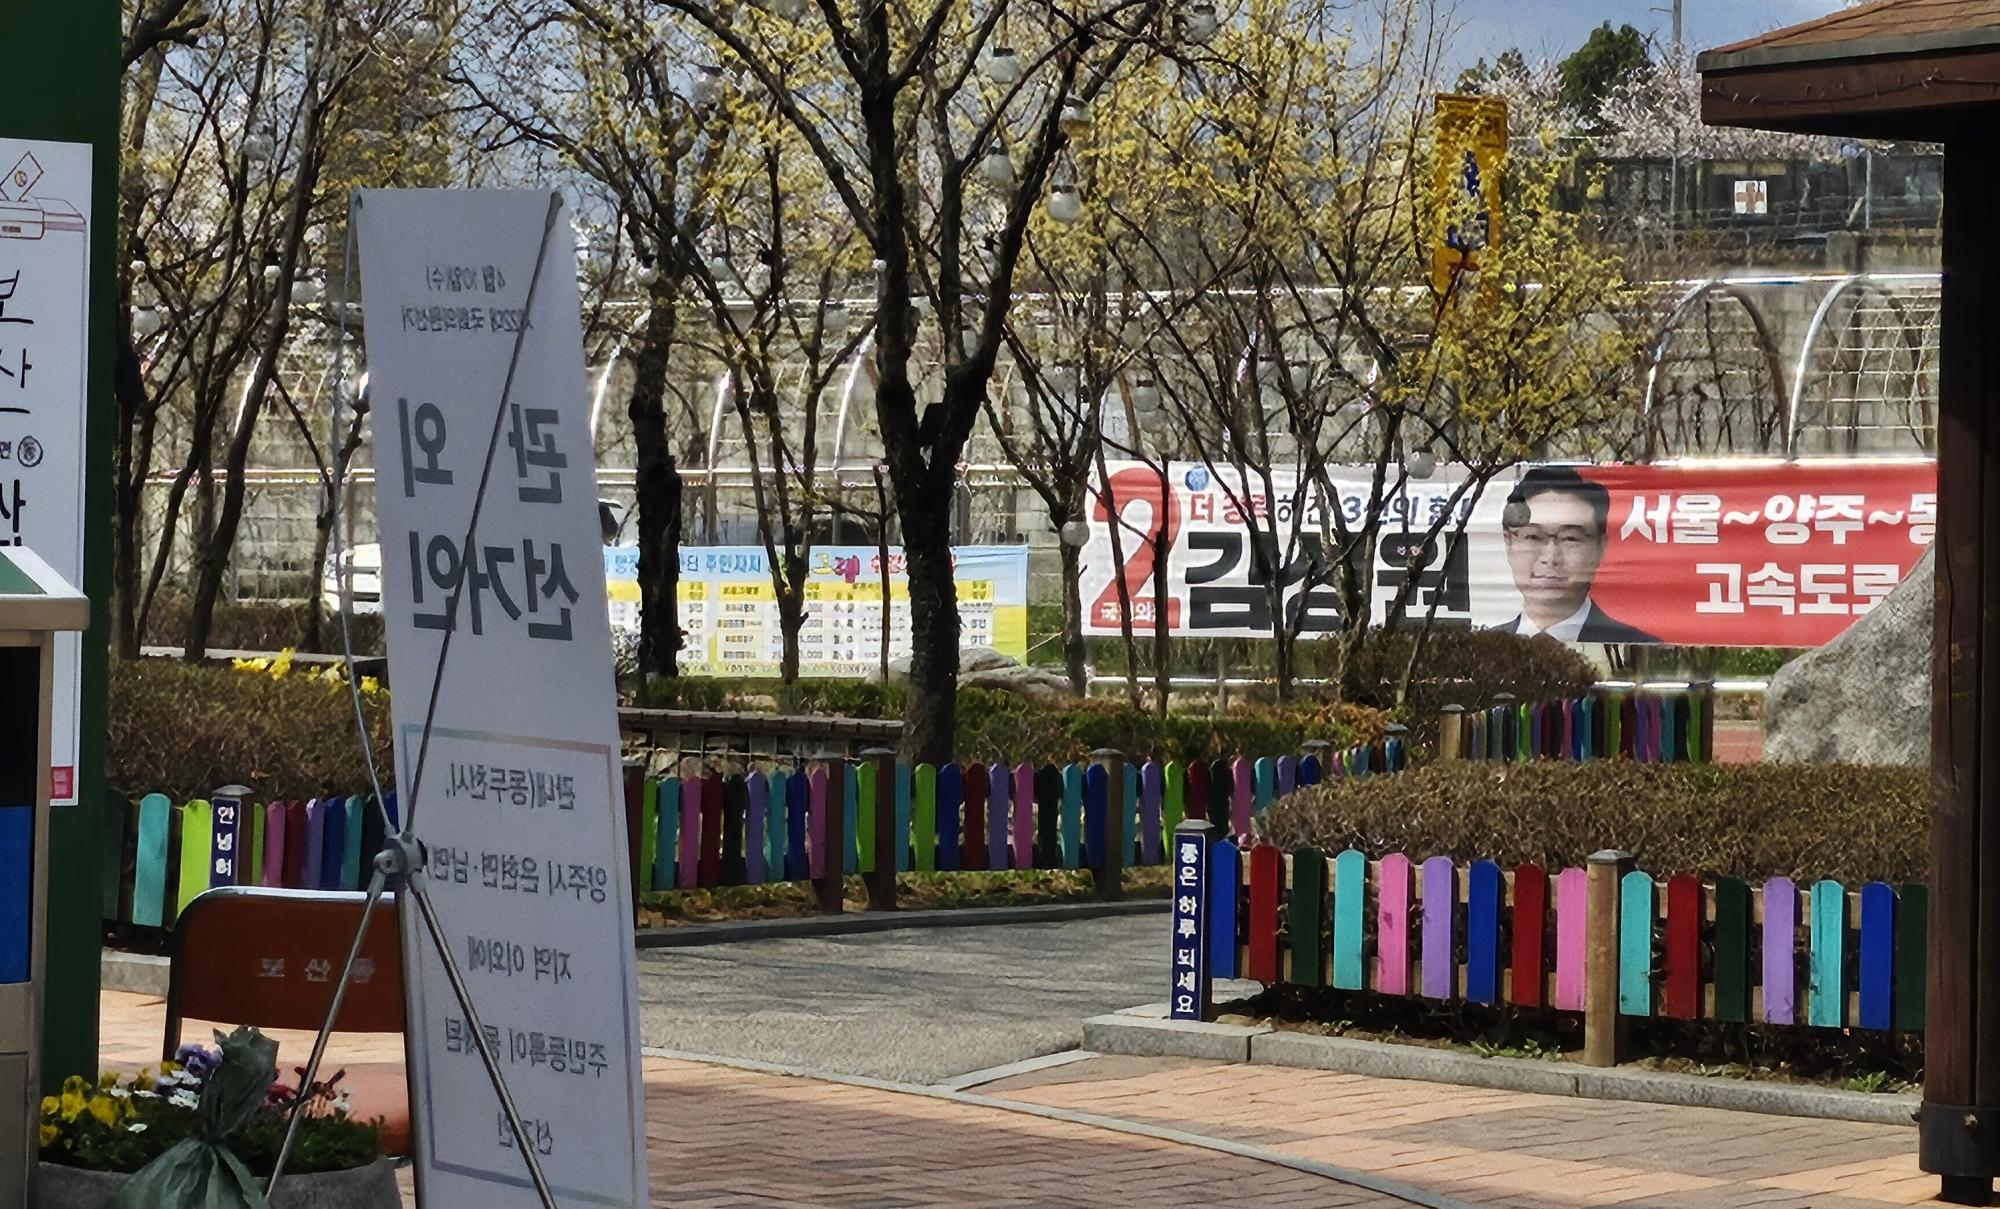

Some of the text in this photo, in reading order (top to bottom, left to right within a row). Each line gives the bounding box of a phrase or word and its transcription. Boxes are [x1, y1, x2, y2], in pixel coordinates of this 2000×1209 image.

[1190, 493, 1214, 524] 더
[1695, 562, 1900, 615] 고속도로
[1180, 843, 1198, 887] 좋은
[1178, 896, 1197, 939] 하루
